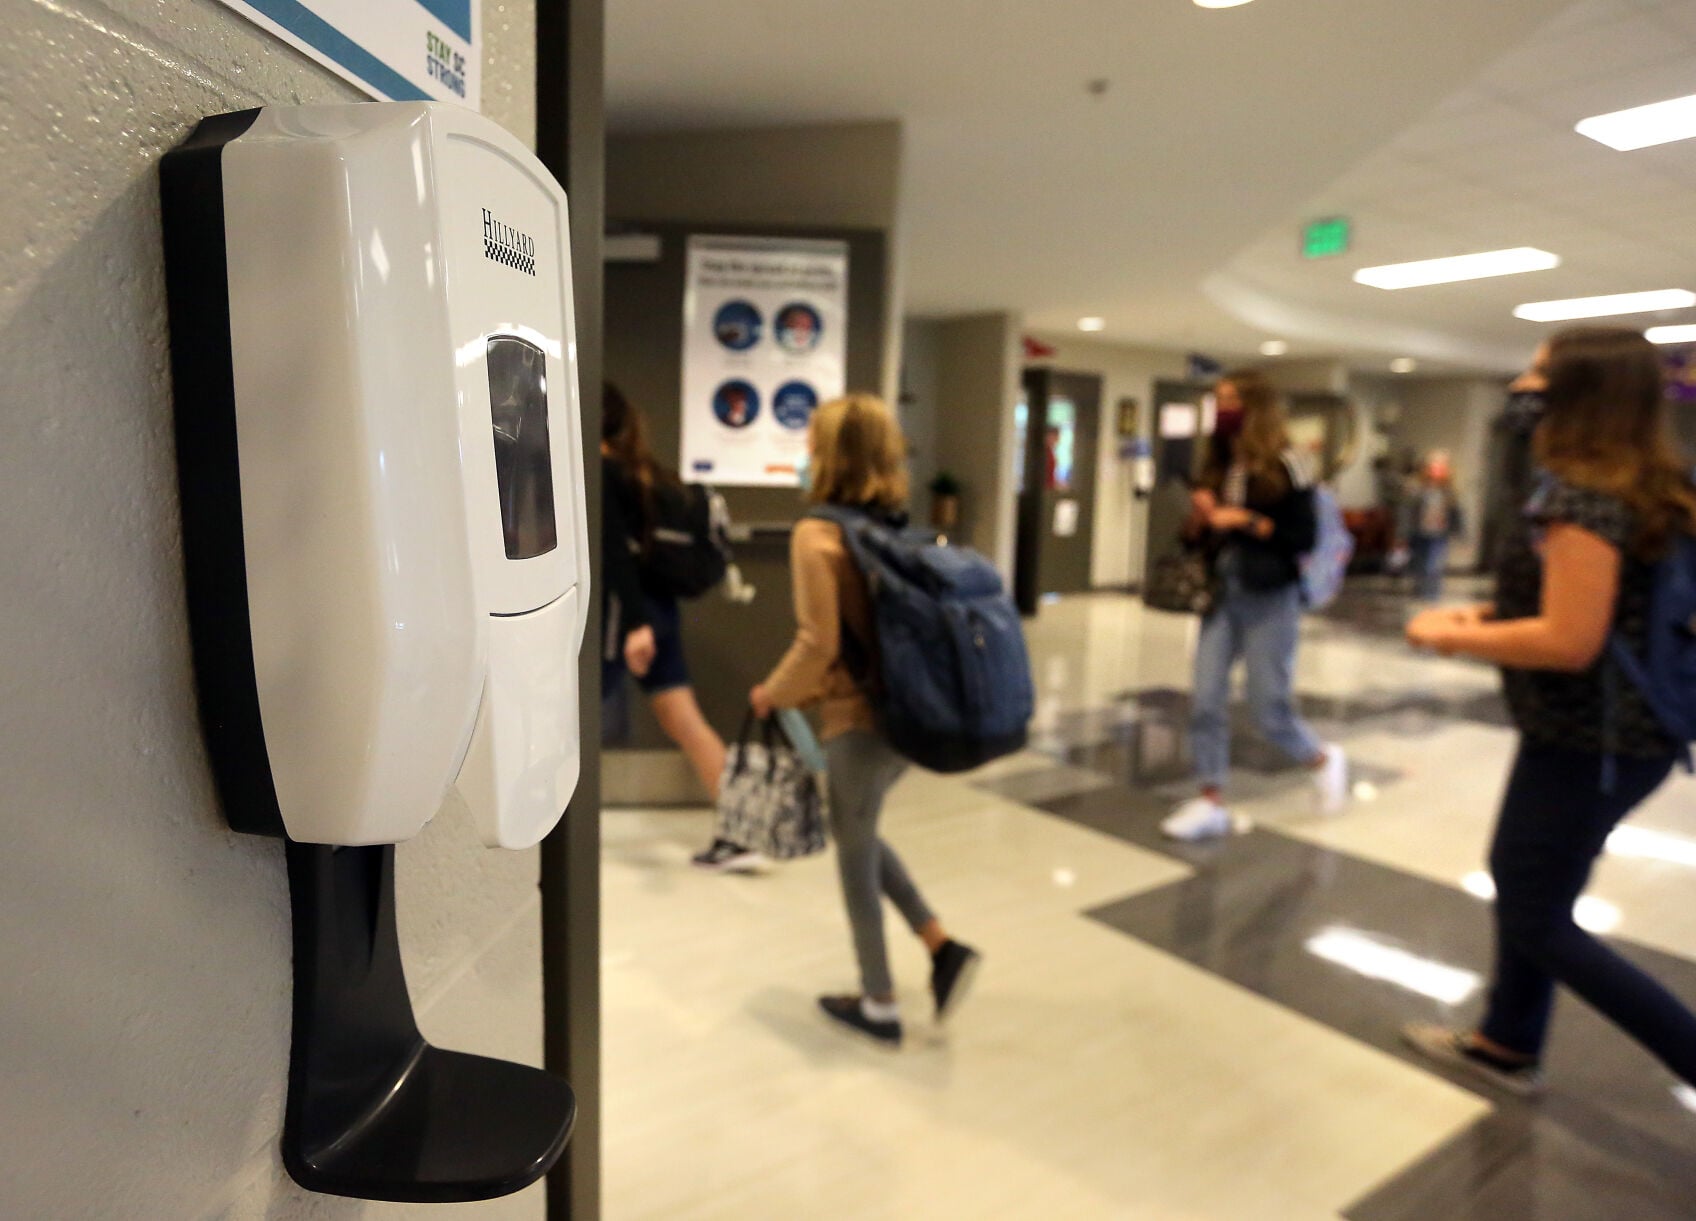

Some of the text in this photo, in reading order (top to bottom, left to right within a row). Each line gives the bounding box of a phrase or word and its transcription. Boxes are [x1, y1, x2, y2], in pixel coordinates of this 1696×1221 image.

[427, 30, 451, 65] STAY
[427, 54, 465, 98] STRONG
[481, 207, 535, 258] HILLYARD
